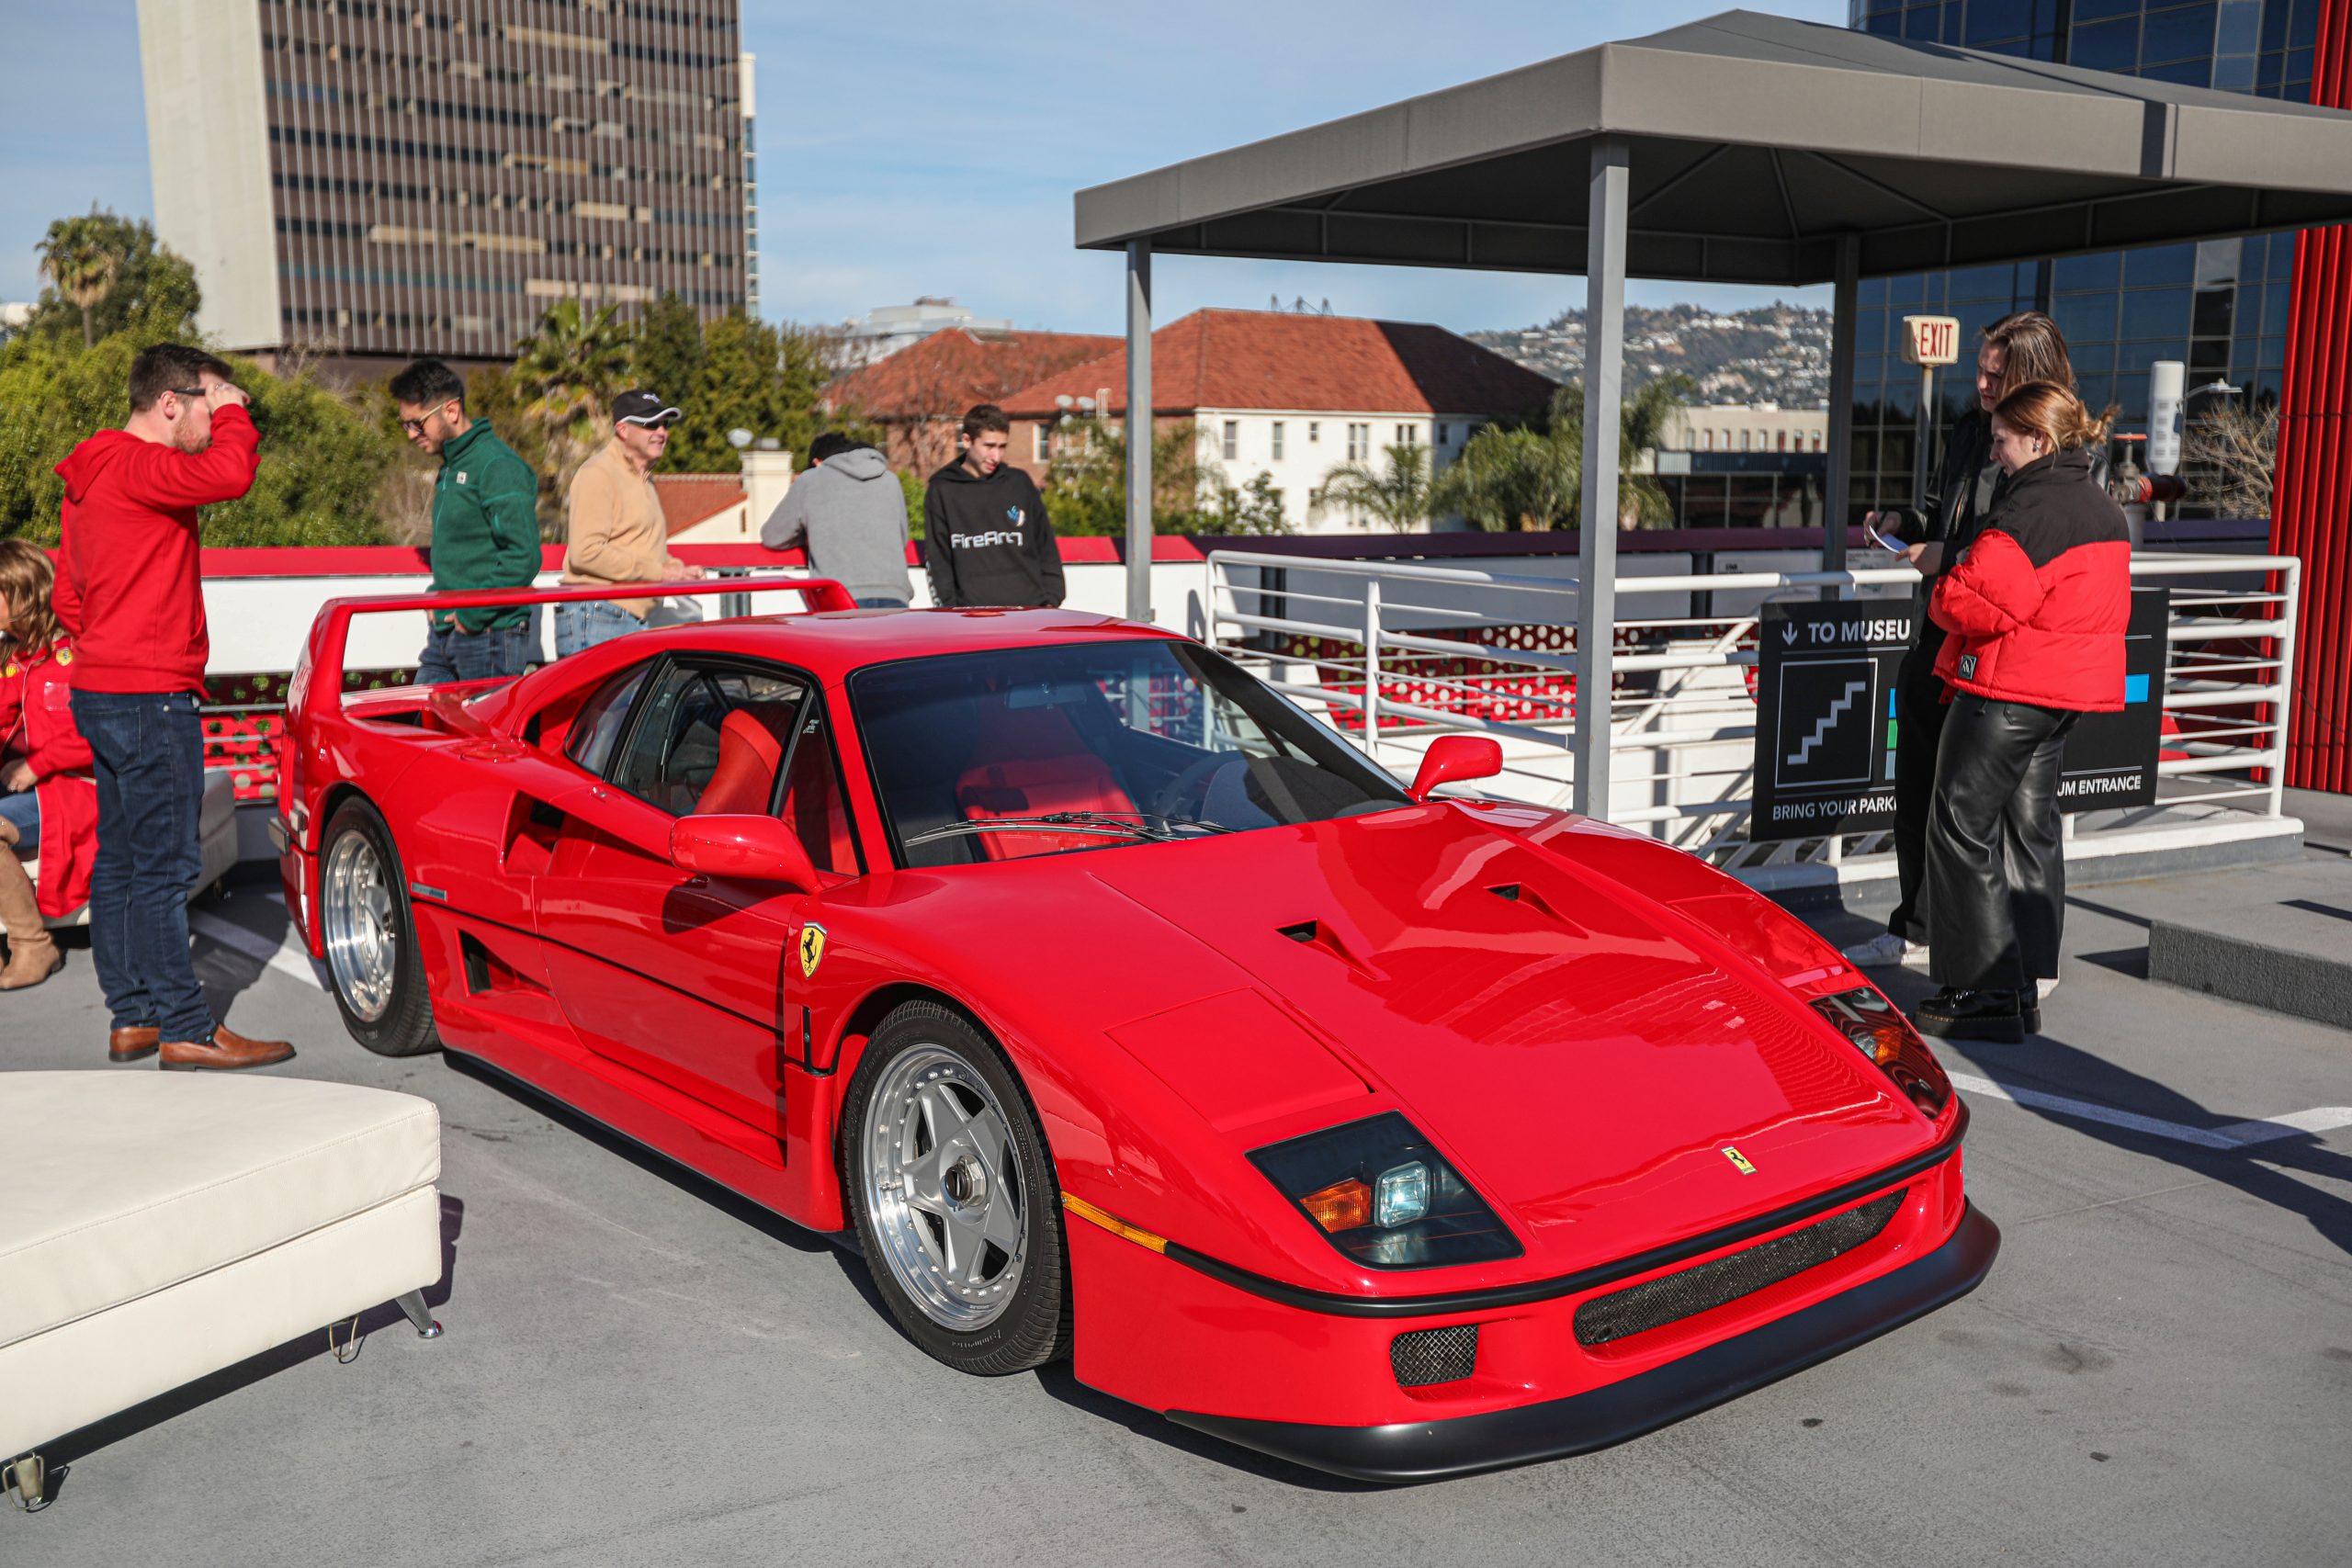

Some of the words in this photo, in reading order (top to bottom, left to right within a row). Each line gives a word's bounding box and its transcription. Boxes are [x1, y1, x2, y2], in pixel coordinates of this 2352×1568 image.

[1920, 322, 1952, 357] EXIT
[1808, 622, 1836, 643] TO
[1841, 618, 1911, 642] MUSEU
[2078, 774, 2142, 795] ENTRANCE
[1773, 802, 1815, 820] BRING
[1818, 798, 1857, 817] YOUR
